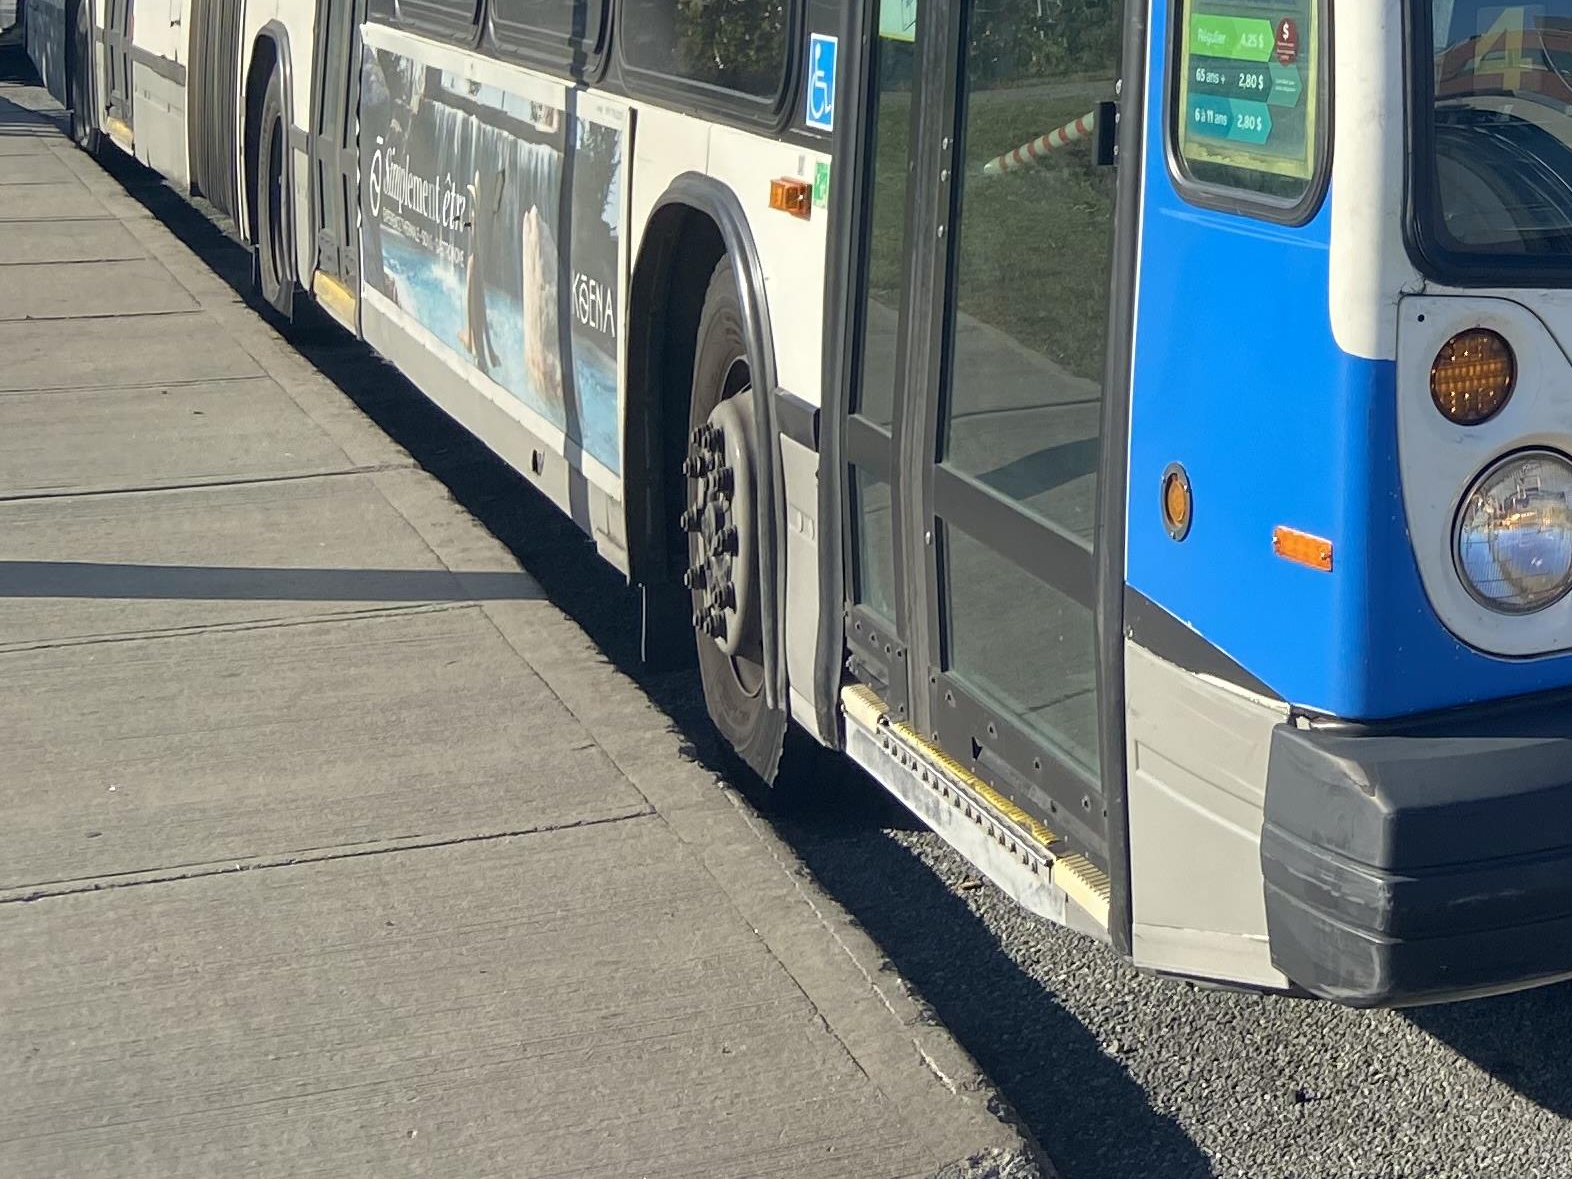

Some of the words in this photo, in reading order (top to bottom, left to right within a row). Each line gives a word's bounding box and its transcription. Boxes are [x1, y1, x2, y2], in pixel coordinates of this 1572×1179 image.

[1282, 21, 1290, 41] $
[1196, 68, 1206, 82] 65
[1206, 71, 1220, 84] ans
[1239, 72, 1257, 90] 2,80
[1258, 74, 1264, 91] $
[1194, 108, 1200, 122] 6
[1207, 110, 1214, 123] 11
[1214, 114, 1228, 127] ans
[1237, 114, 1256, 131] 2,80
[1256, 116, 1263, 132] $
[383, 147, 441, 224] Simplement
